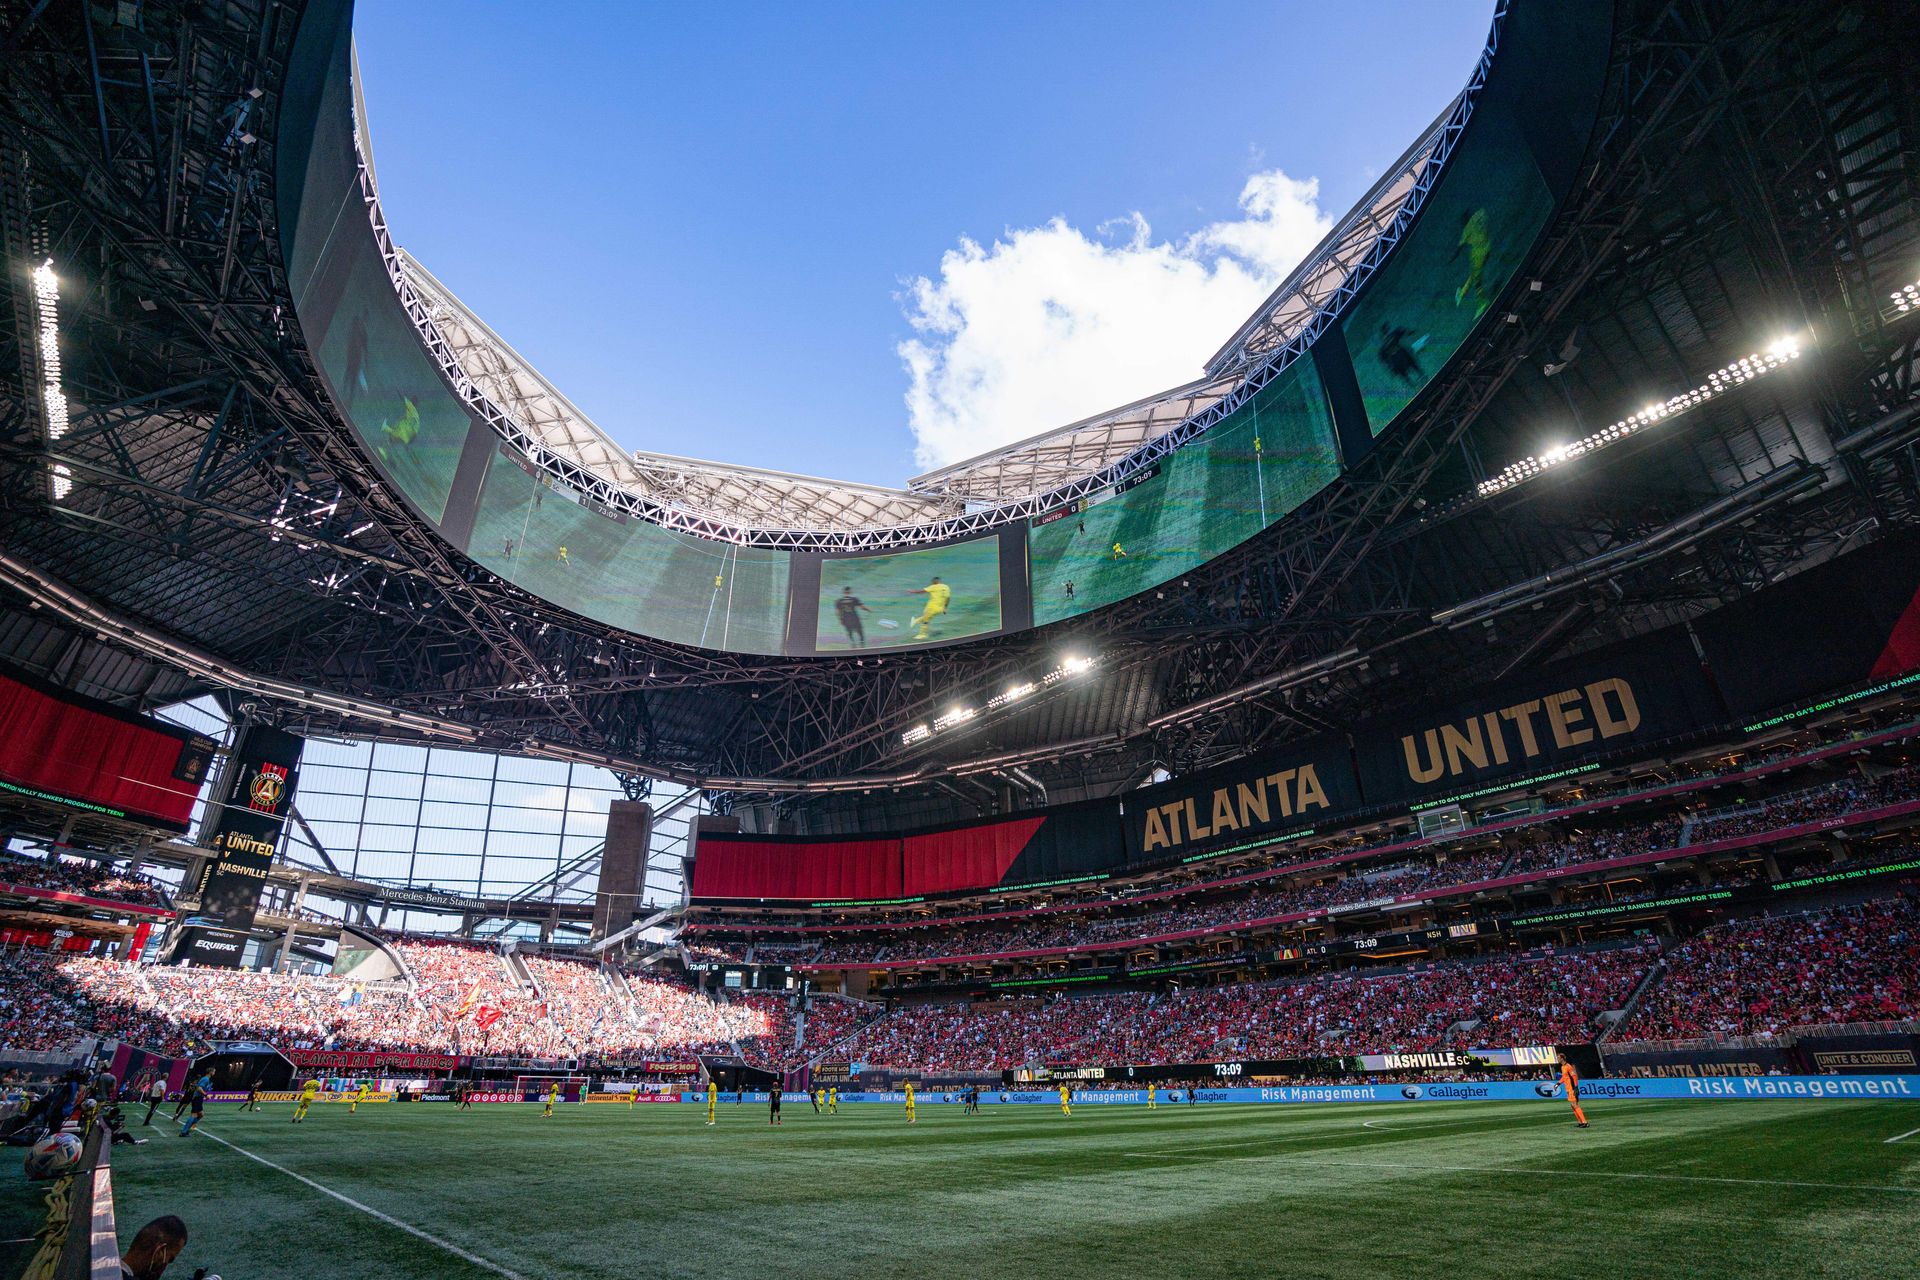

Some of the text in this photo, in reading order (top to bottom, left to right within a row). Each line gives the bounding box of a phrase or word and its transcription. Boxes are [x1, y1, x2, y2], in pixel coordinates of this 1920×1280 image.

[508, 454, 527, 470] UNITED
[1133, 470, 1152, 485] 73:09
[598, 507, 617, 519] 73:09
[1042, 513, 1062, 523] UNITED
[1744, 723, 1762, 733] TAKE
[1763, 717, 1783, 726] THEM
[1796, 707, 1814, 717] GA'S
[1815, 700, 1836, 711] ONLY
[1837, 684, 1888, 704] NATIONALLY
[1144, 677, 1641, 851] ATLANTA UNITED
[1475, 784, 1509, 796] NATIONALLY
[1510, 779, 1534, 788] RANKED
[1535, 772, 1565, 782] PROGRAM
[1580, 763, 1600, 771] TEENS
[38, 793, 63, 802] RANKED
[64, 799, 93, 810] PROGRAM
[107, 809, 125, 817] TEENS
[230, 831, 254, 840] ATLANTA
[227, 836, 274, 856] UNITED
[219, 862, 267, 879] NASHVILLE
[1846, 870, 1866, 878] ONLY
[380, 888, 485, 908] Mercedes-Benz Stadium
[1328, 902, 1369, 914] Mercedes-Benz
[1370, 898, 1394, 907] Stadium
[1587, 906, 1625, 916] NATIONALLY
[1656, 897, 1690, 906] PROGRAM
[195, 939, 239, 951] EQUIFAX
[1354, 938, 1377, 949] 73:09
[1426, 930, 1441, 939] NSH
[284, 1051, 348, 1065] ATLANTA
[1339, 1060, 1344, 1070] 1
[1384, 1053, 1470, 1069] NASHVILLE SC
[1819, 1054, 1911, 1064] UNITE & CONQUER
[1077, 1068, 1104, 1079] UNITED
[1128, 1067, 1134, 1077] 0
[1215, 1063, 1242, 1075] 73:09
[1429, 1086, 1488, 1099] Gallagher
[1576, 1083, 1640, 1097] allagher
[1688, 1077, 1911, 1096] Risk Management
[880, 1093, 893, 1101] Risk
[1013, 1094, 1042, 1103] Gallagher
[1081, 1091, 1139, 1102] Management
[1262, 1087, 1375, 1101] Risk Management
